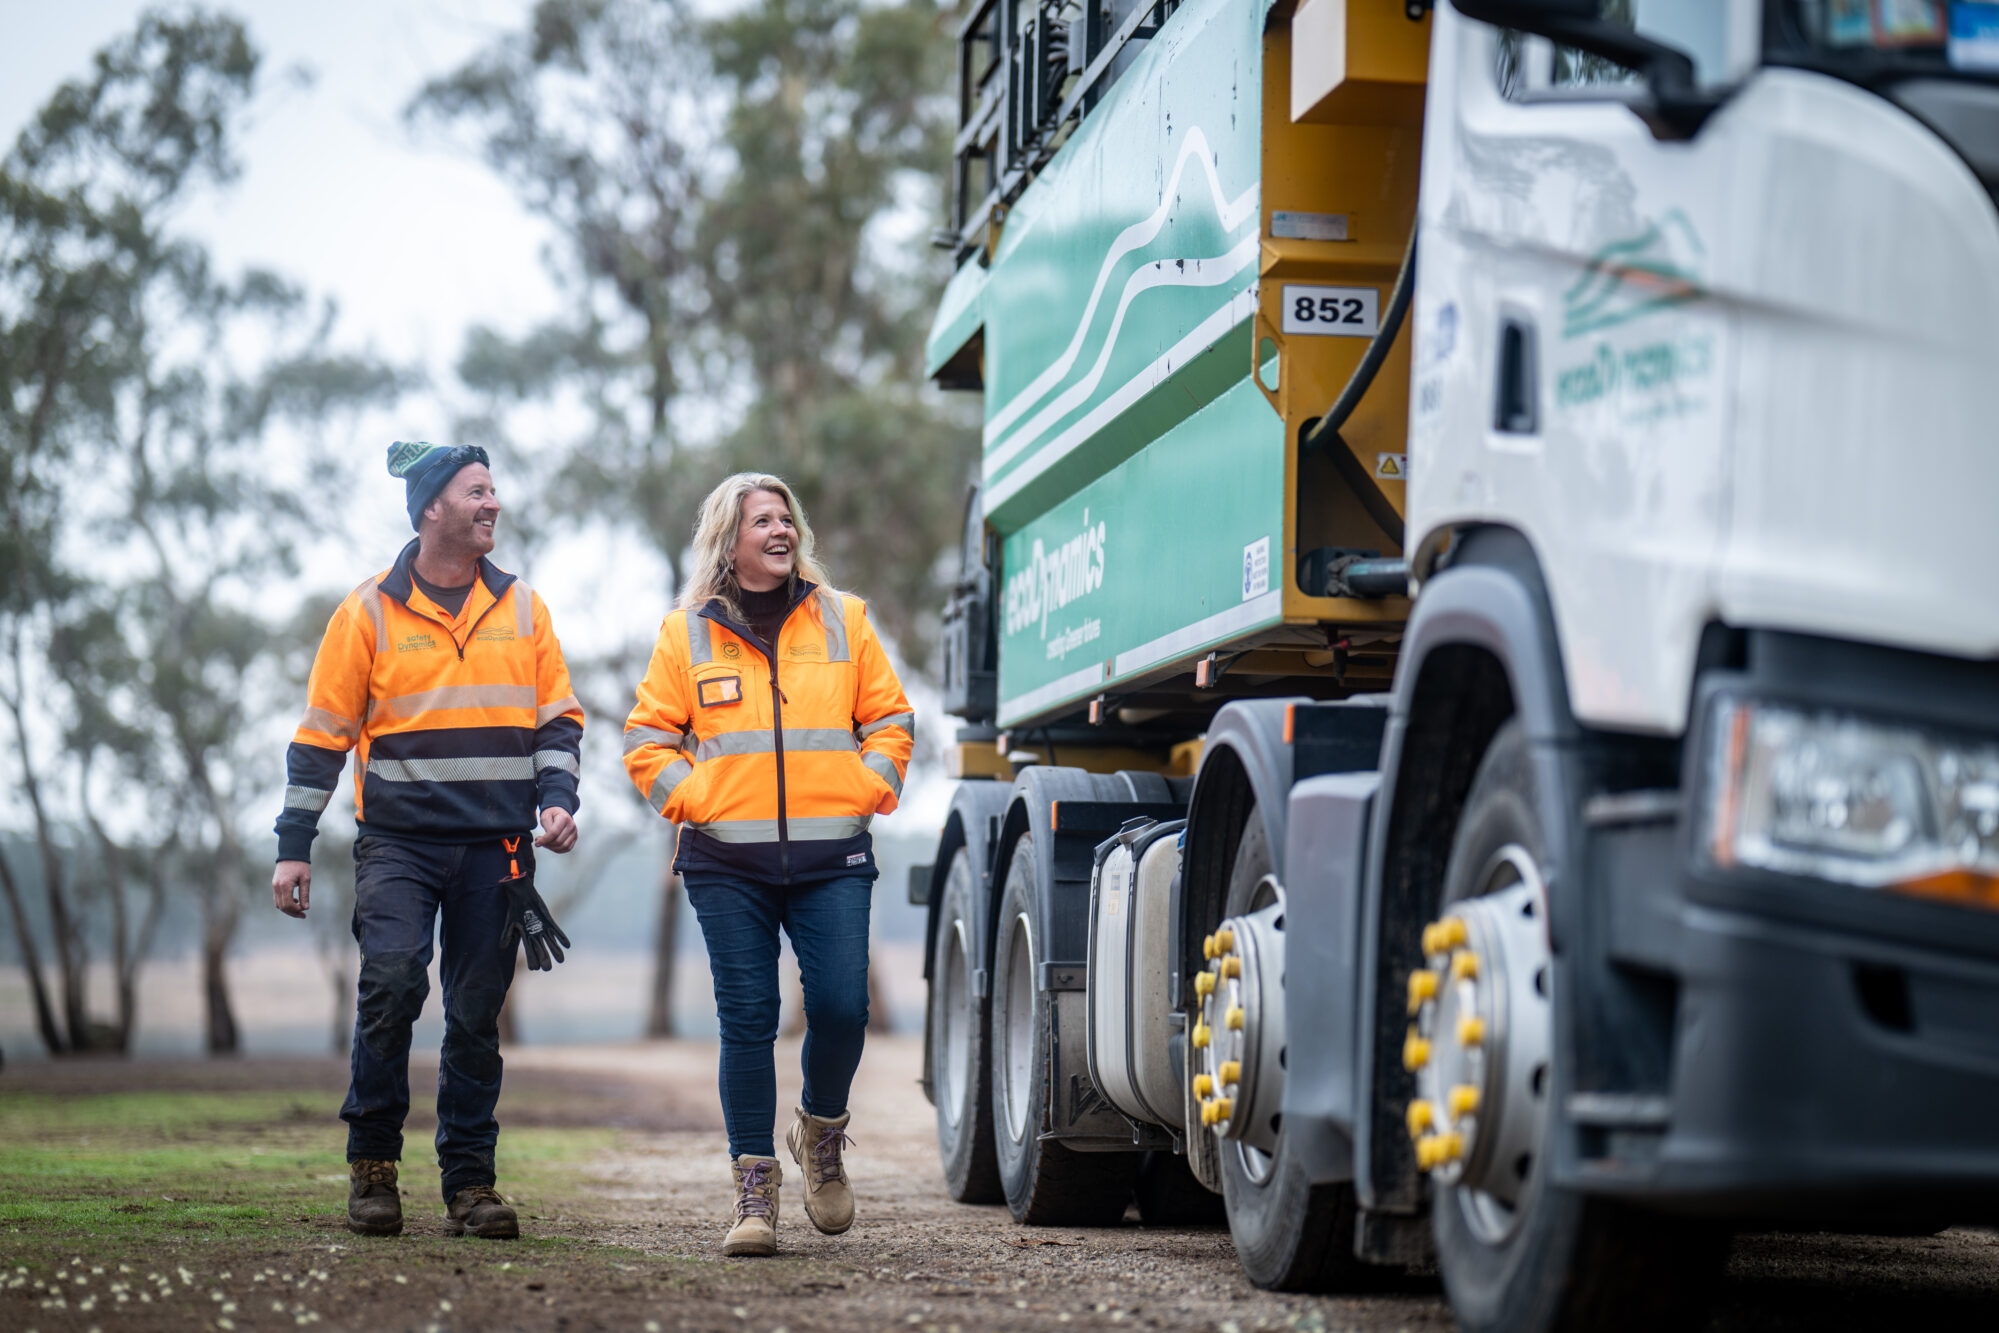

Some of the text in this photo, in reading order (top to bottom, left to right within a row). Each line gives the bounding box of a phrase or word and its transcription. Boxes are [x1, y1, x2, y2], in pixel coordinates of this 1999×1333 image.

[1294, 296, 1364, 325] 852
[1006, 507, 1106, 640] ecoDynamics
[397, 639, 437, 651] Dynamics
